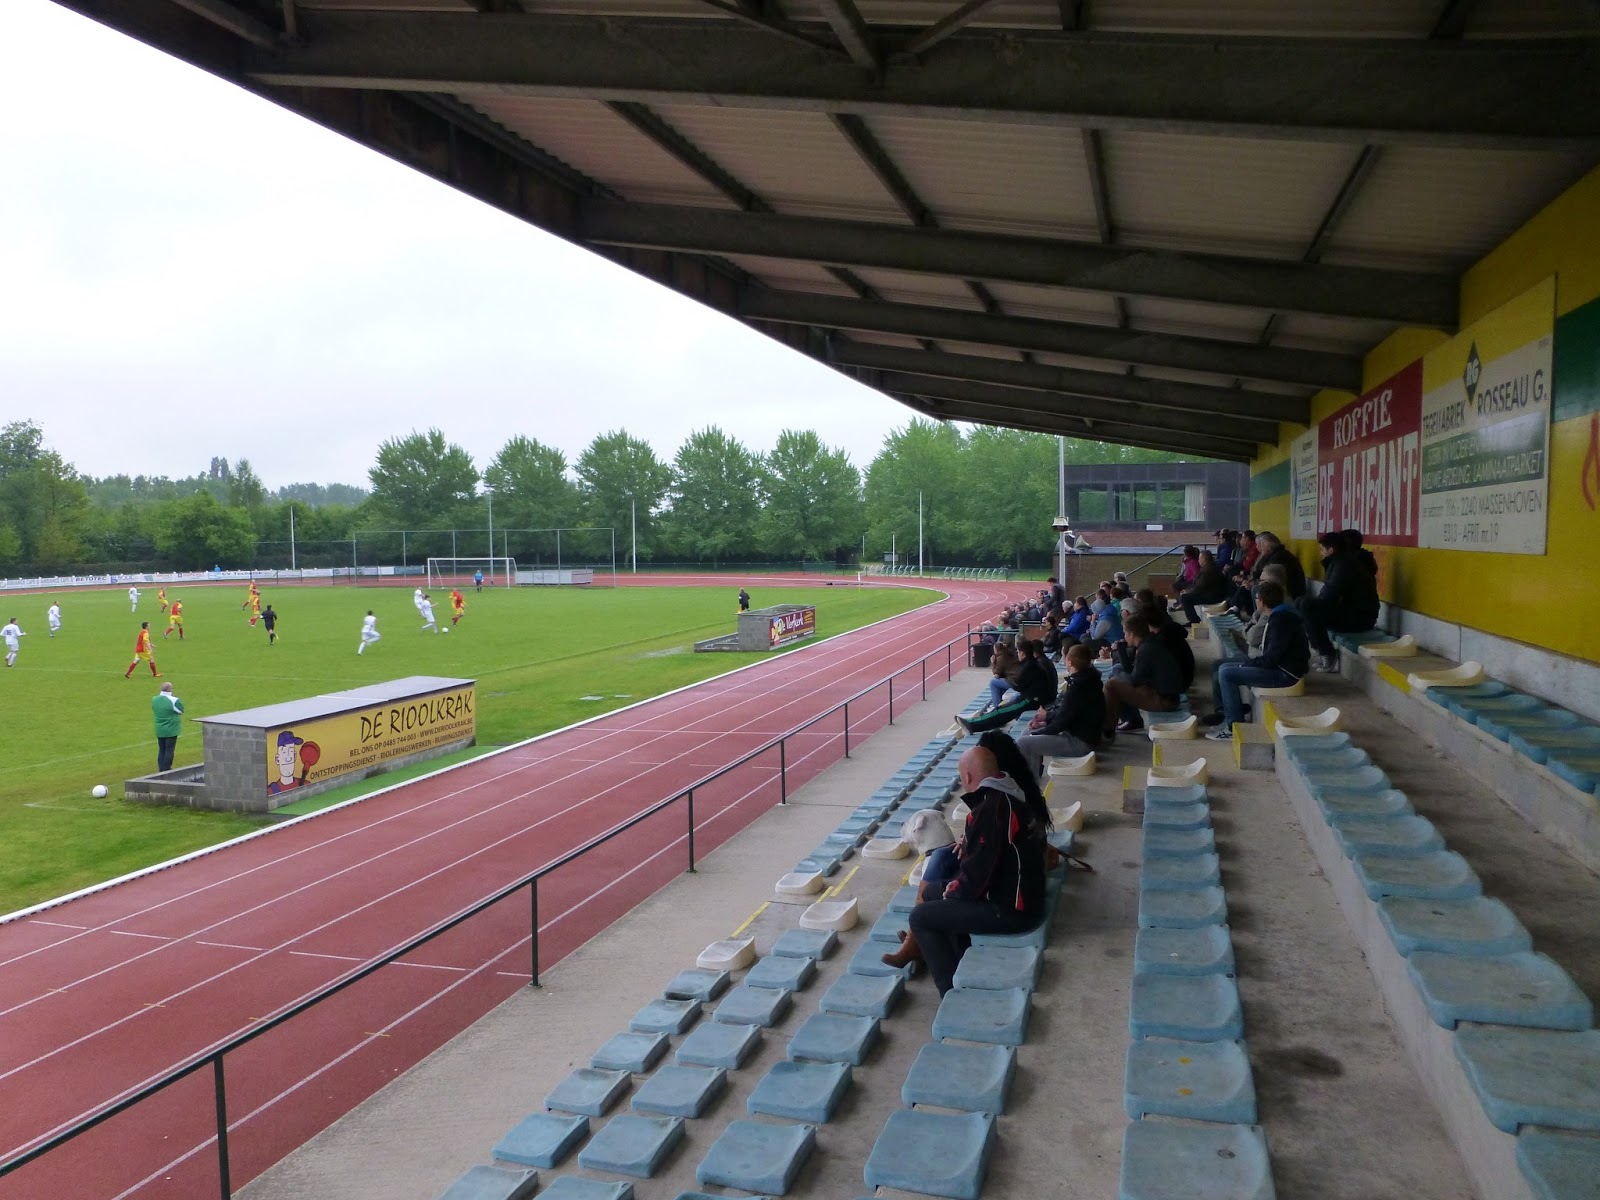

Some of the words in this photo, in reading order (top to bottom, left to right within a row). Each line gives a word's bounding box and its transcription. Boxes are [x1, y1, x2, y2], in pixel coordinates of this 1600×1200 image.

[1477, 374, 1529, 416] ROSSEAU
[1533, 368, 1548, 402] G.
[1333, 389, 1393, 450] KOFFIE
[1319, 461, 1335, 534] DE
[1341, 430, 1419, 536] OLIFANT
[1478, 489, 1543, 515] MASSENHOVEN
[360, 711, 383, 743] DE
[390, 691, 473, 734] RIOOLKRAK
[310, 754, 377, 780] ONTSTOPPINGSDIENST
[380, 741, 432, 760] RIOLERINGSWERKEN
[350, 749, 360, 757] BEL
[361, 745, 373, 755] ONS
[374, 743, 383, 752] OP
[383, 739, 396, 748] 0485
[397, 736, 407, 745] 744
